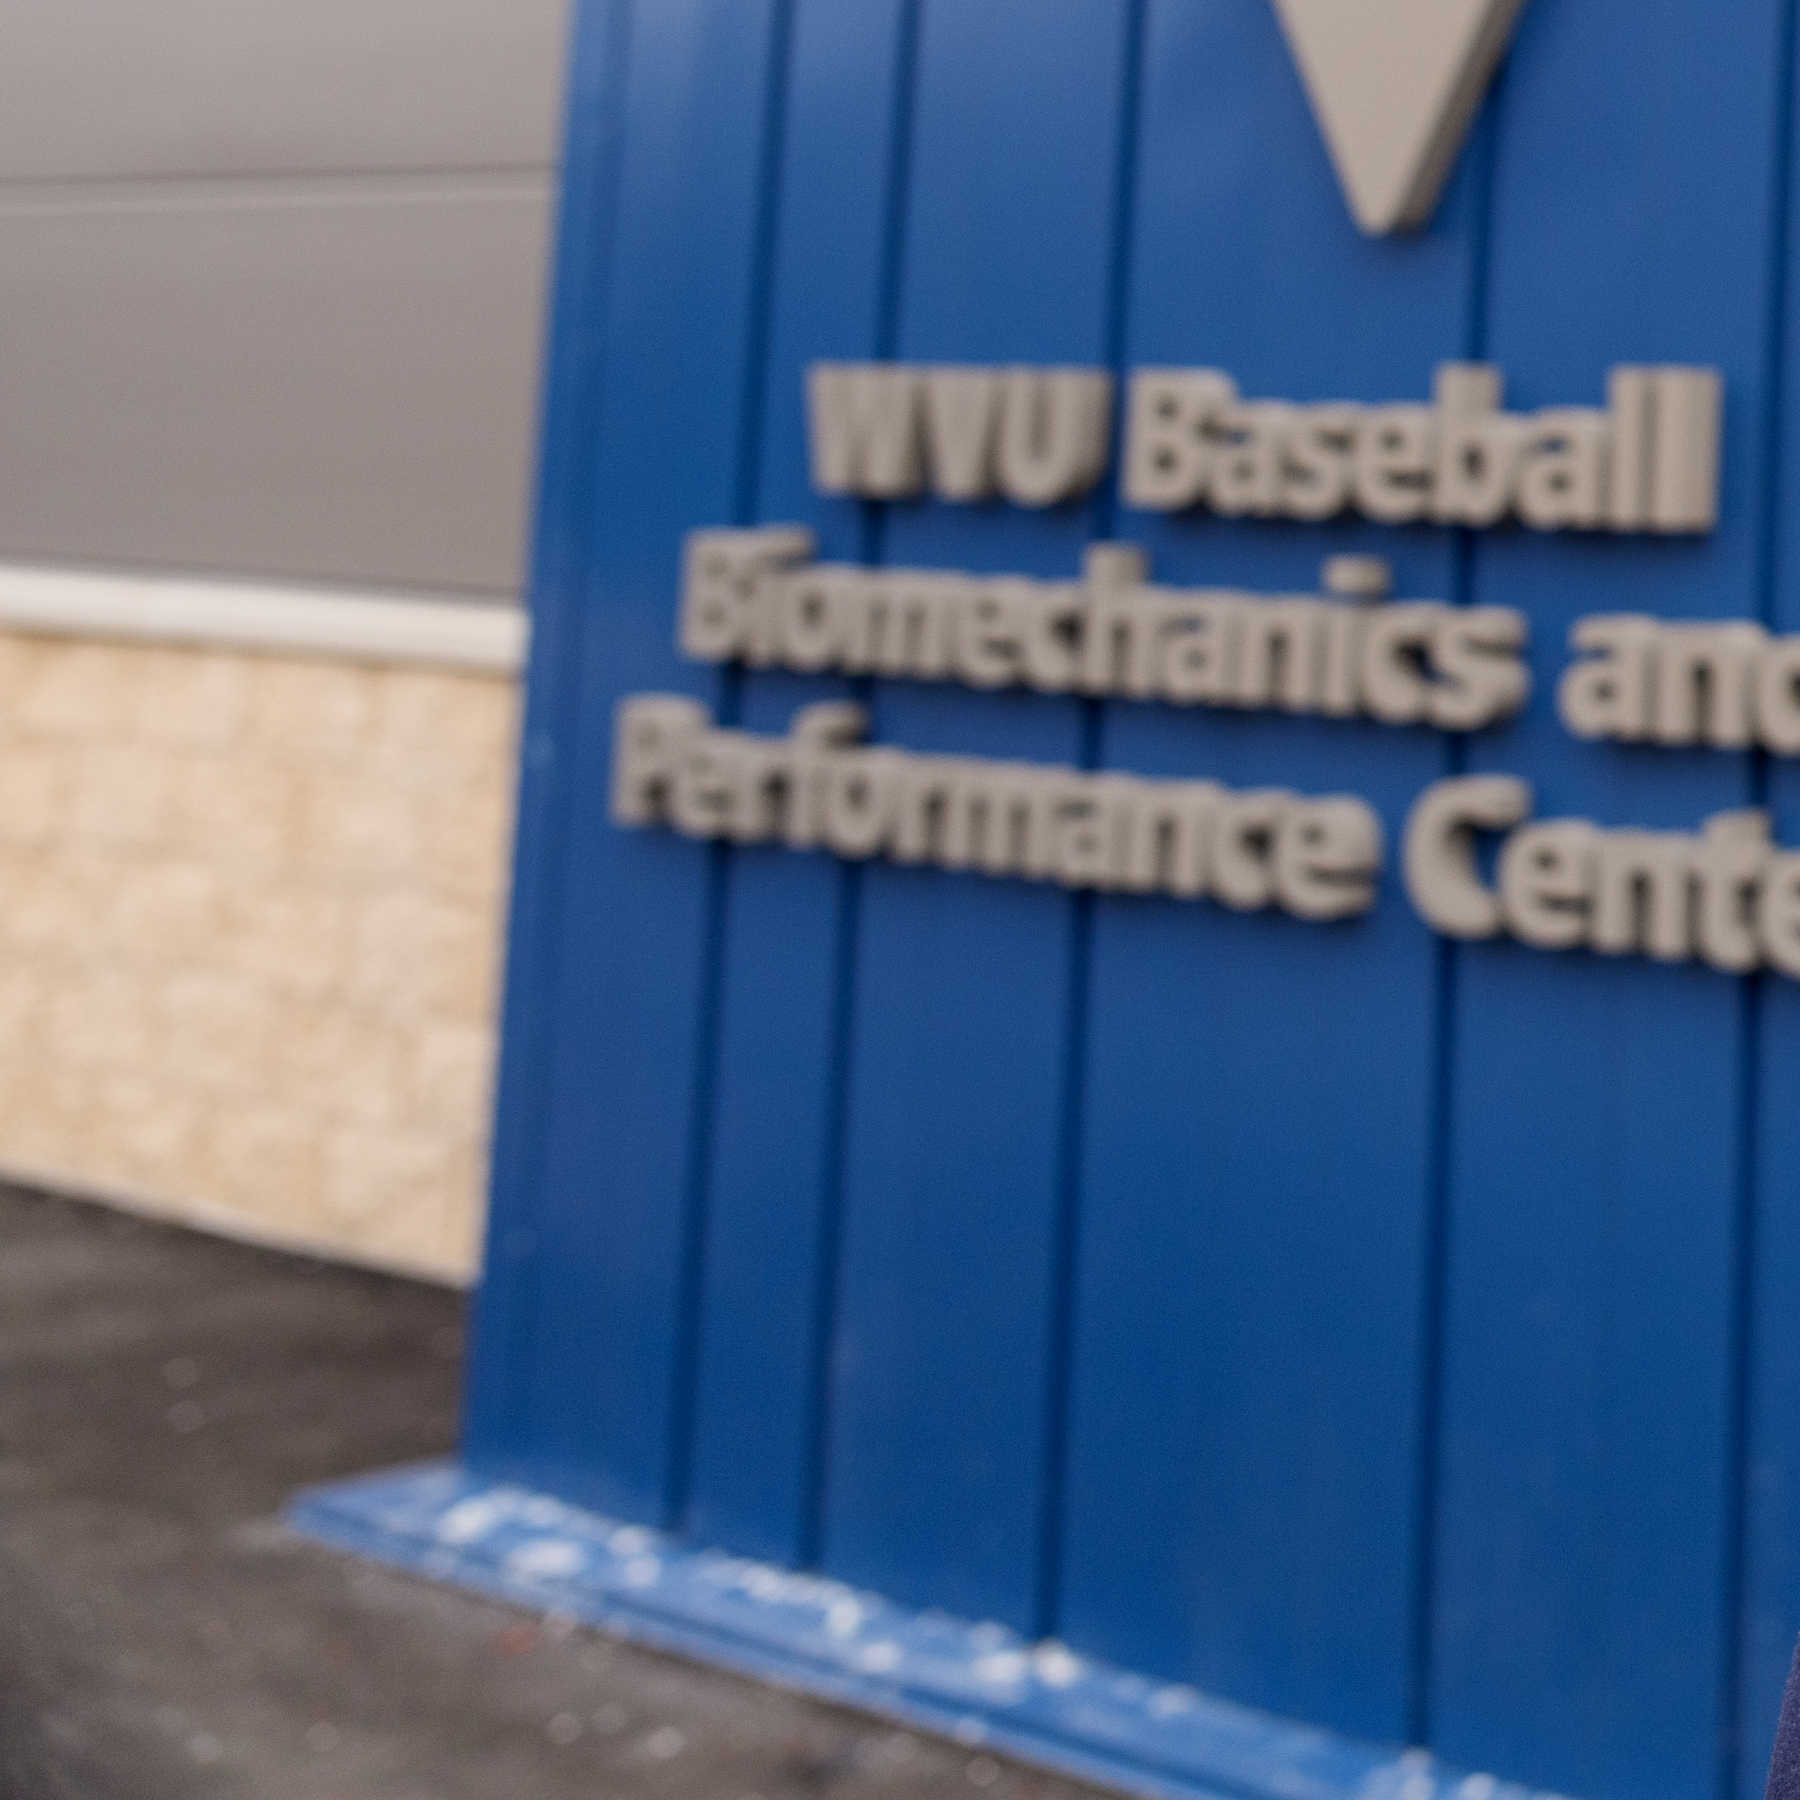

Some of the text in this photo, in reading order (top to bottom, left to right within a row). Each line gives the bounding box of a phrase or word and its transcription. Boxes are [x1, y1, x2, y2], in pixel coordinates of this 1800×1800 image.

[808, 360, 1722, 535] WVU Baseball
[678, 526, 1529, 728] Biomechanics
[612, 694, 1382, 920] Performance
